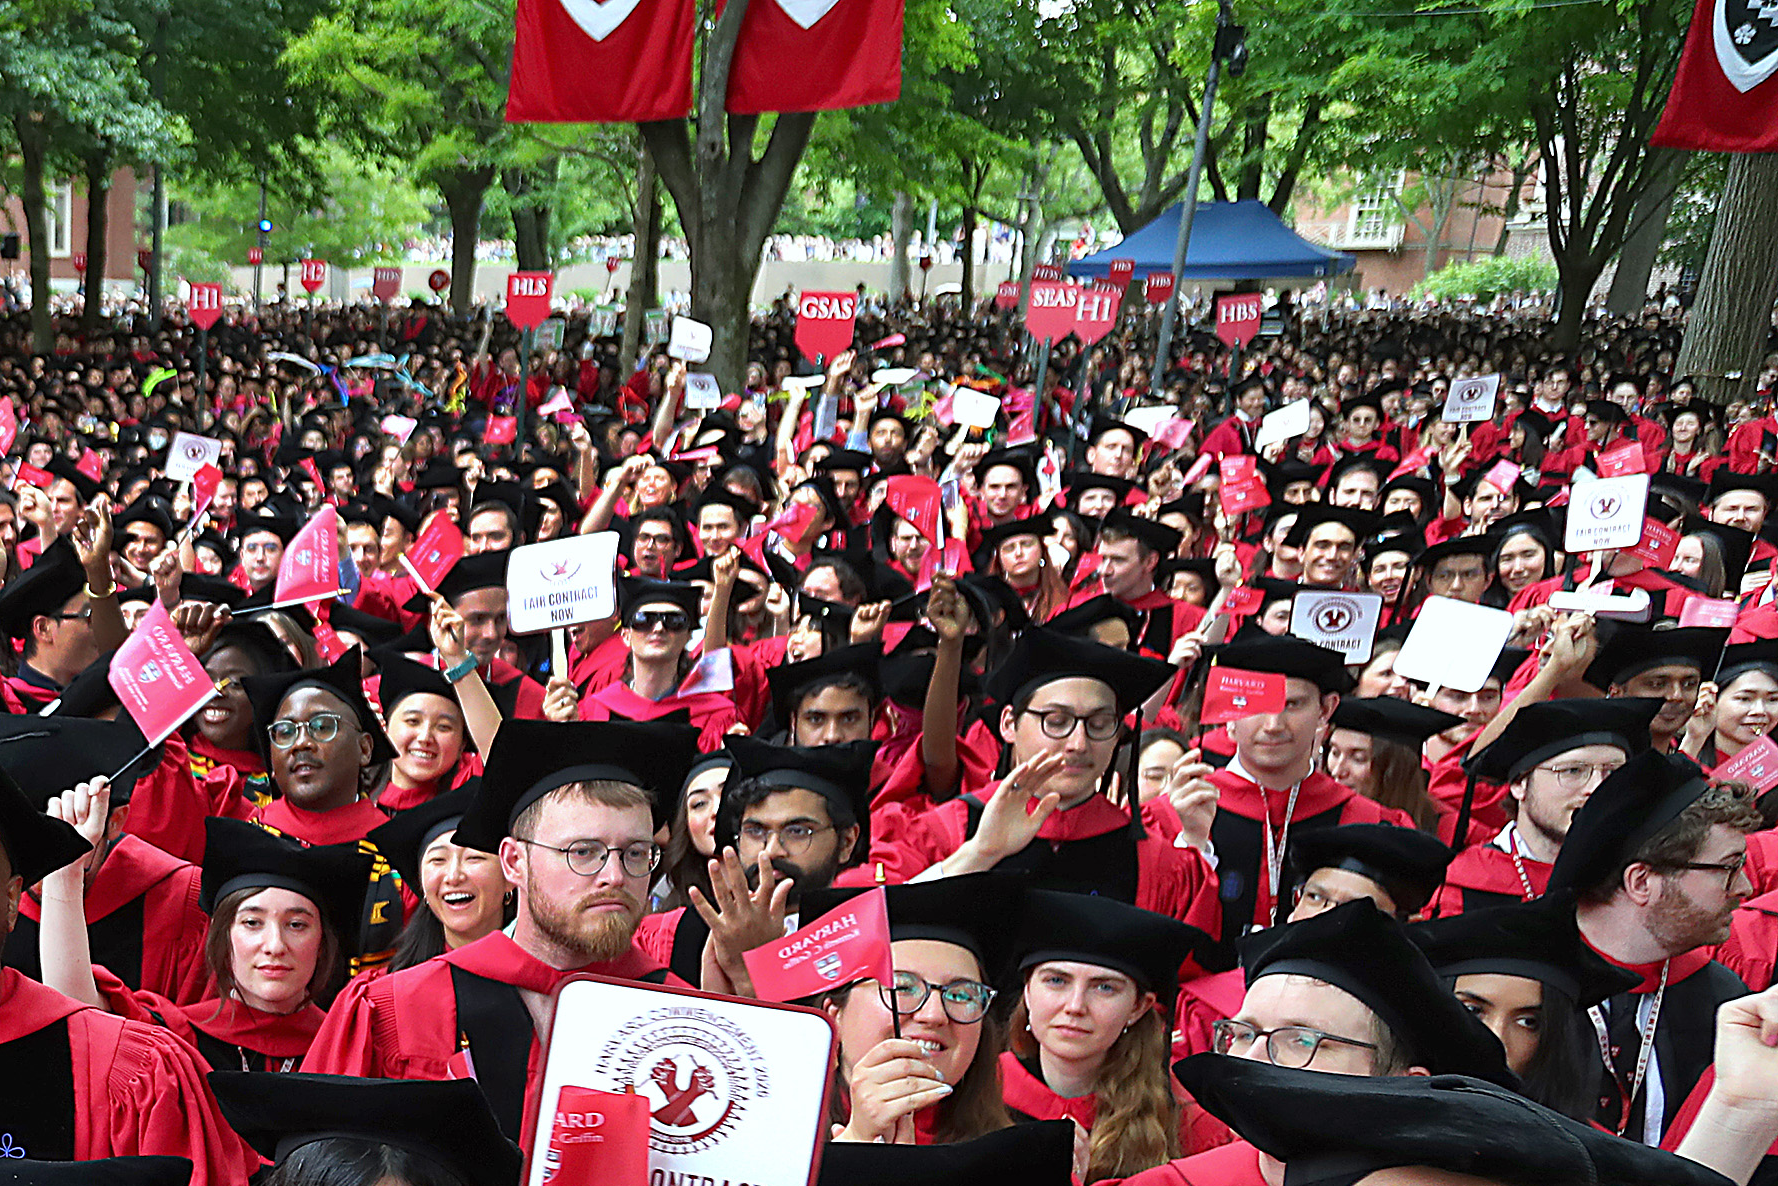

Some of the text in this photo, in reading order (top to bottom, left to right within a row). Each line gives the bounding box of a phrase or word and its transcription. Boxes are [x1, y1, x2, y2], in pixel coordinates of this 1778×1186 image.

[513, 277, 547, 296] HLS
[1033, 288, 1078, 307] SEAS
[801, 296, 854, 320] GSAS
[1221, 301, 1257, 323] HBS
[1594, 538, 1610, 546] NOW
[524, 586, 598, 610] FAIR CONTRACT
[550, 606, 574, 623] NOW
[1319, 639, 1361, 650] CONTRACT
[753, 1065, 771, 1098] 2026
